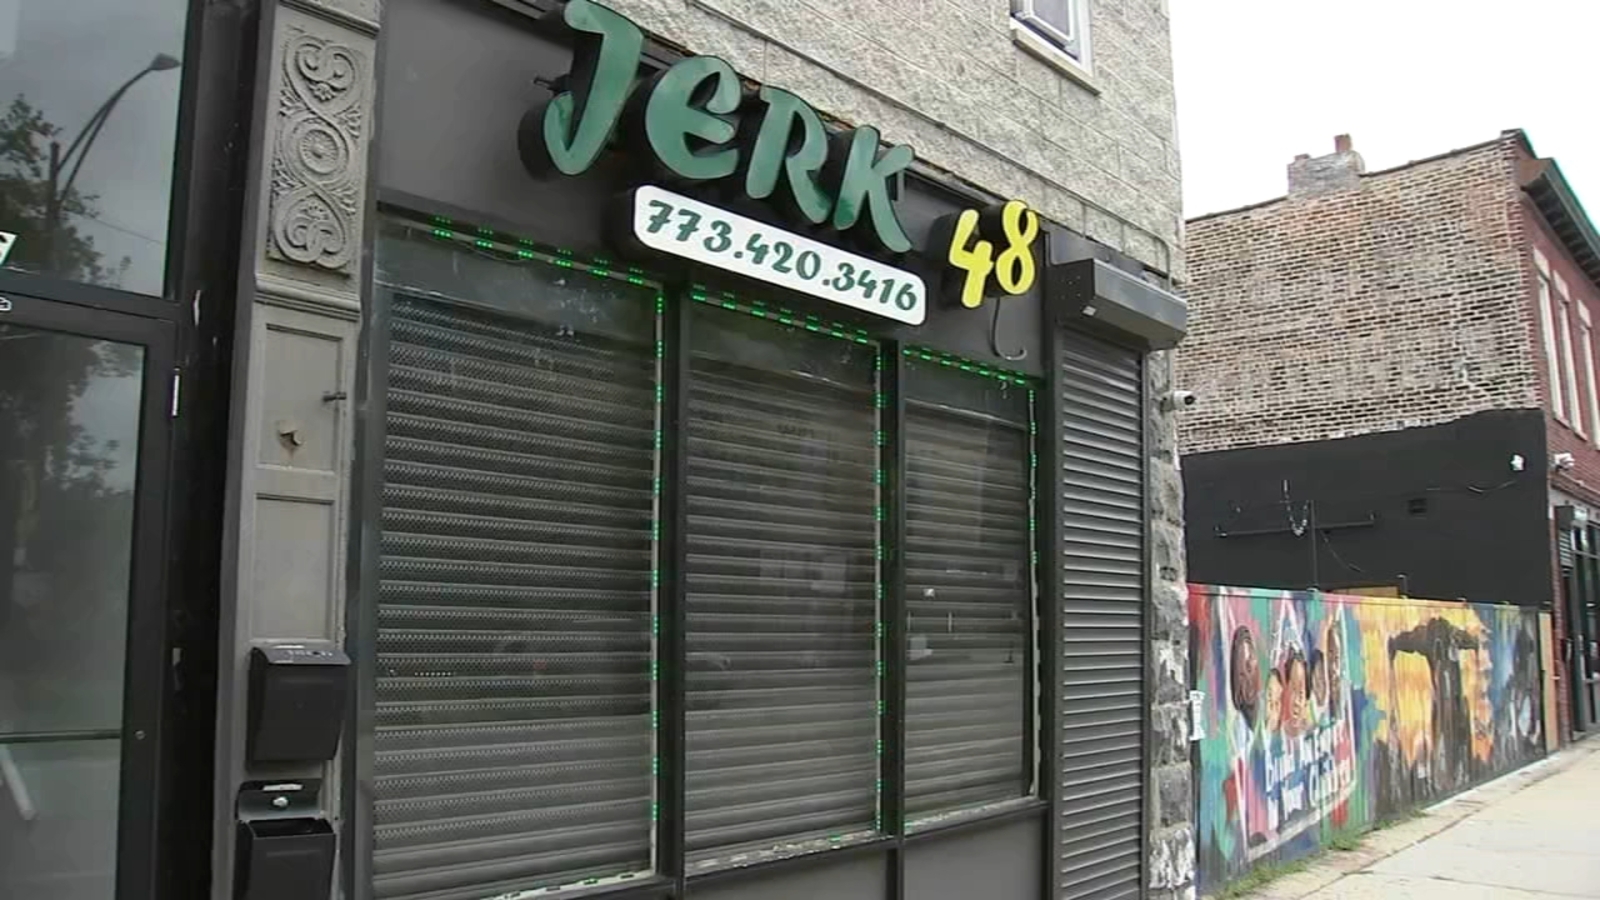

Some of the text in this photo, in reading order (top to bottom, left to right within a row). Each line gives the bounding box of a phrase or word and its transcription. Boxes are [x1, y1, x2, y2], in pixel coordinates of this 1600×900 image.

[543, 0, 1038, 307] JERK 48
[646, 199, 917, 311] 773.420.3416
